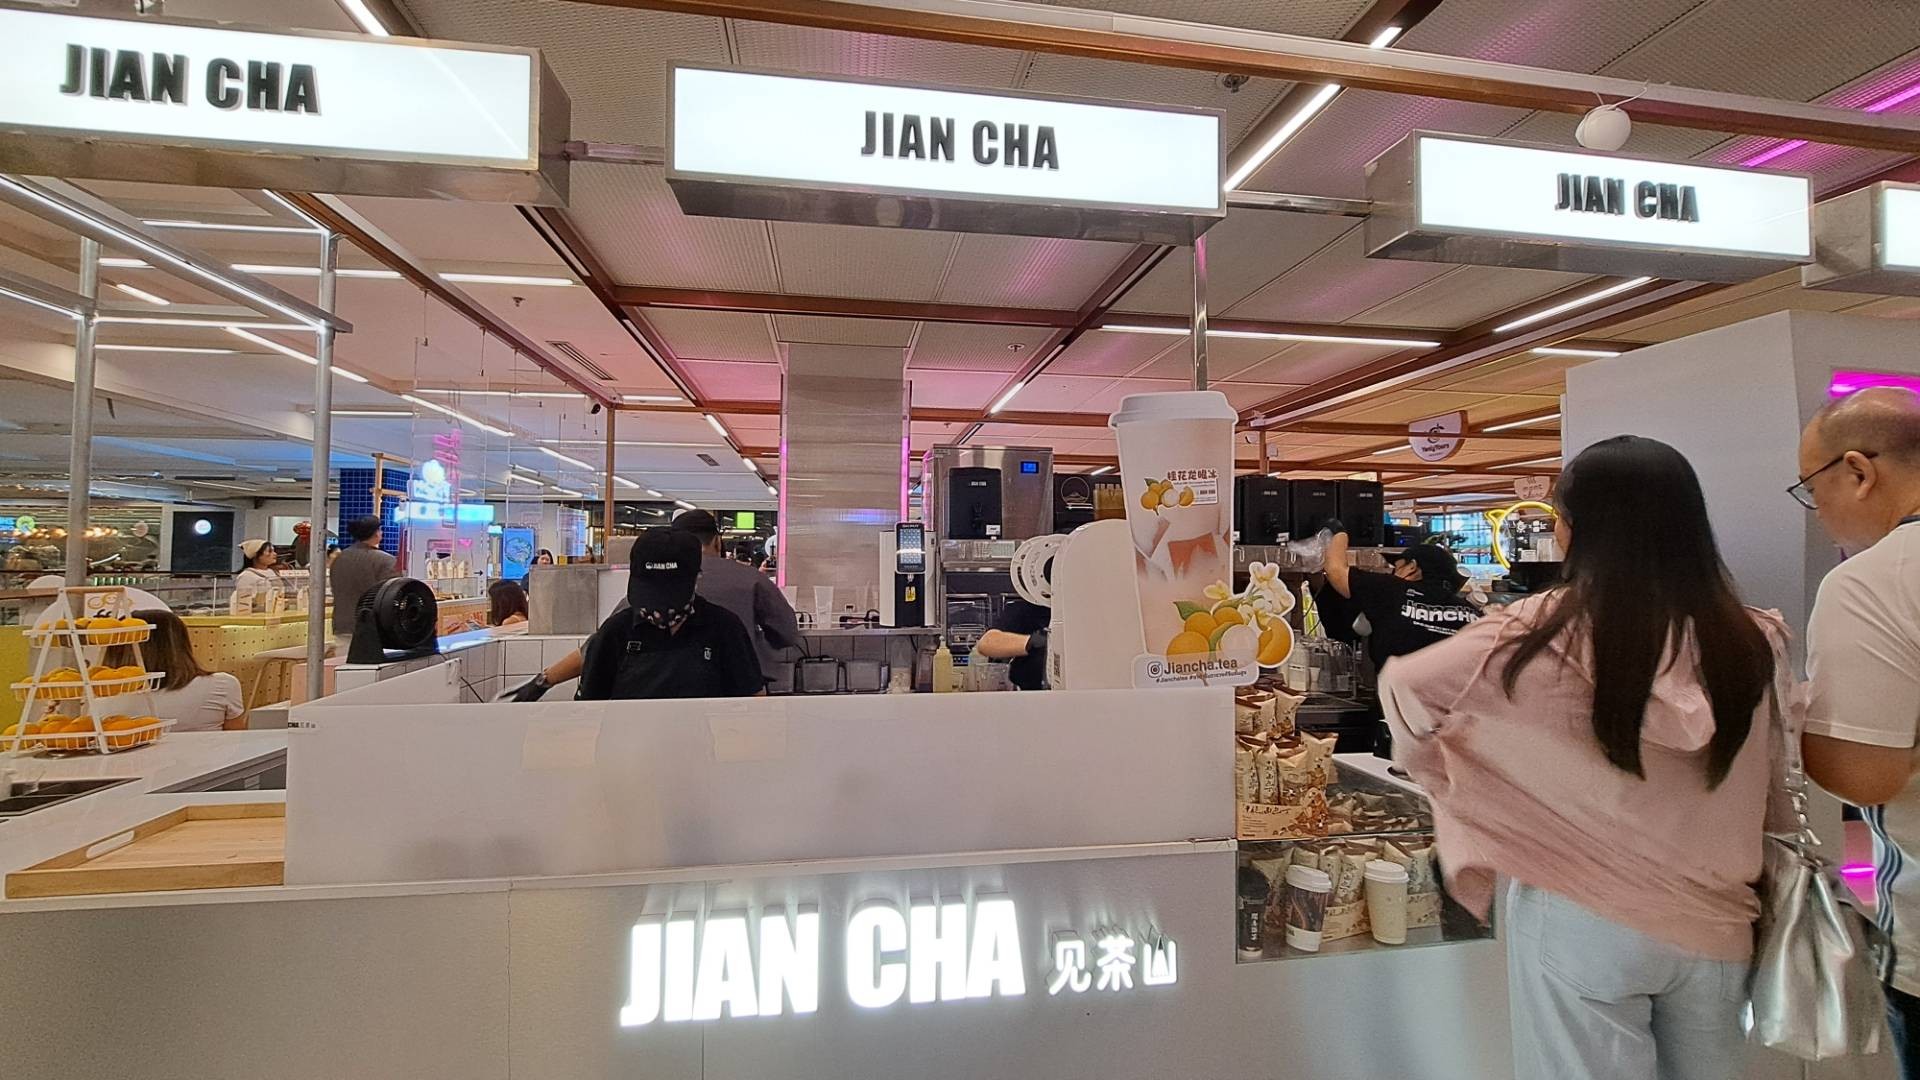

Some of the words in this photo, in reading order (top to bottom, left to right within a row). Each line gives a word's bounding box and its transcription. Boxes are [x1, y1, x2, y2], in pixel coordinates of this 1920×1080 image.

[60, 44, 189, 104] JIAN
[205, 57, 320, 115] CHA
[861, 110, 955, 162] JIAN
[972, 120, 1059, 170] CHA
[1555, 173, 1625, 216] JIAN
[1633, 180, 1699, 223] CHA
[1164, 658, 1238, 675] Jiancha.tea
[620, 913, 820, 1027] JIAN
[846, 899, 1026, 1008] CHA
[1049, 933, 1178, 995] 见茶山
